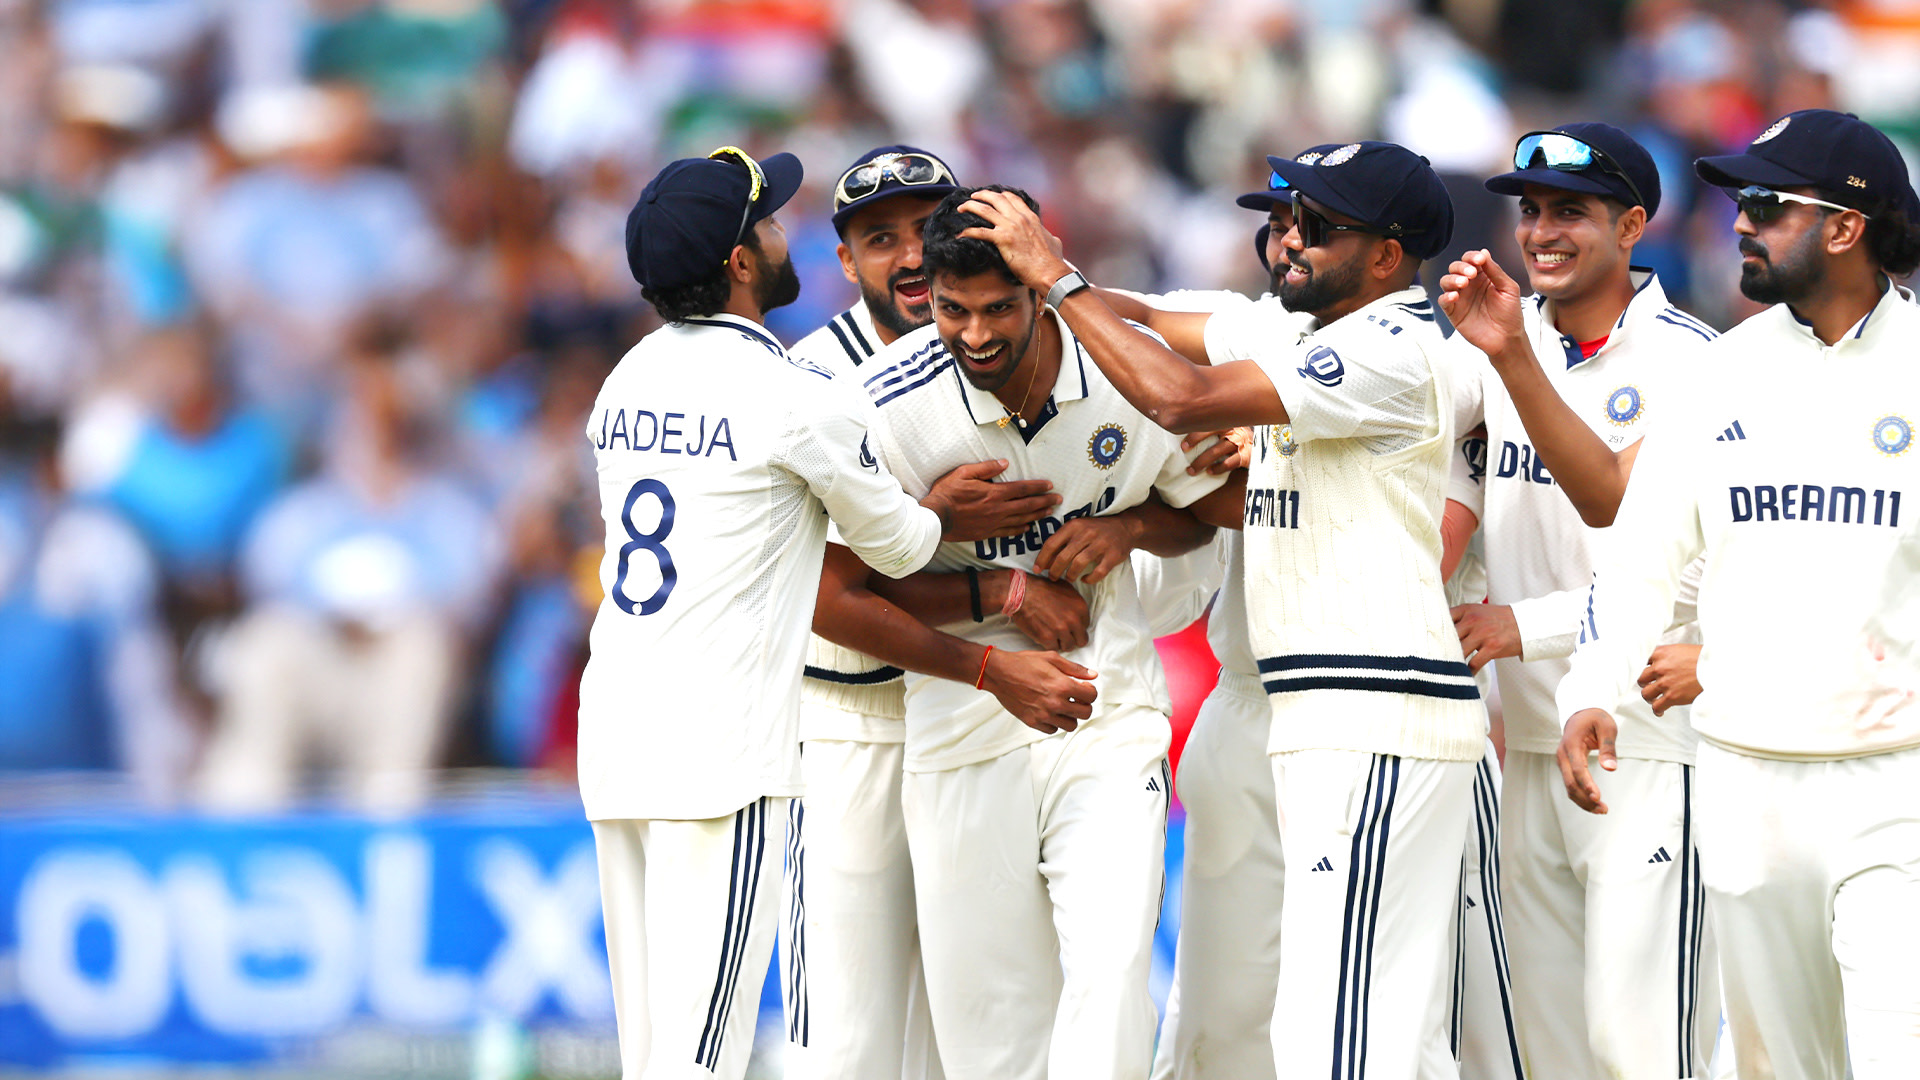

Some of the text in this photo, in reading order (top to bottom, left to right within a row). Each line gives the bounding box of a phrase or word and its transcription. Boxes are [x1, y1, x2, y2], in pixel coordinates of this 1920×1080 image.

[1846, 175, 1867, 189] 284
[596, 408, 738, 462] JADEJA
[1495, 440, 1556, 486] DRE
[1728, 484, 1902, 528] DREAM11
[611, 478, 678, 616] 8
